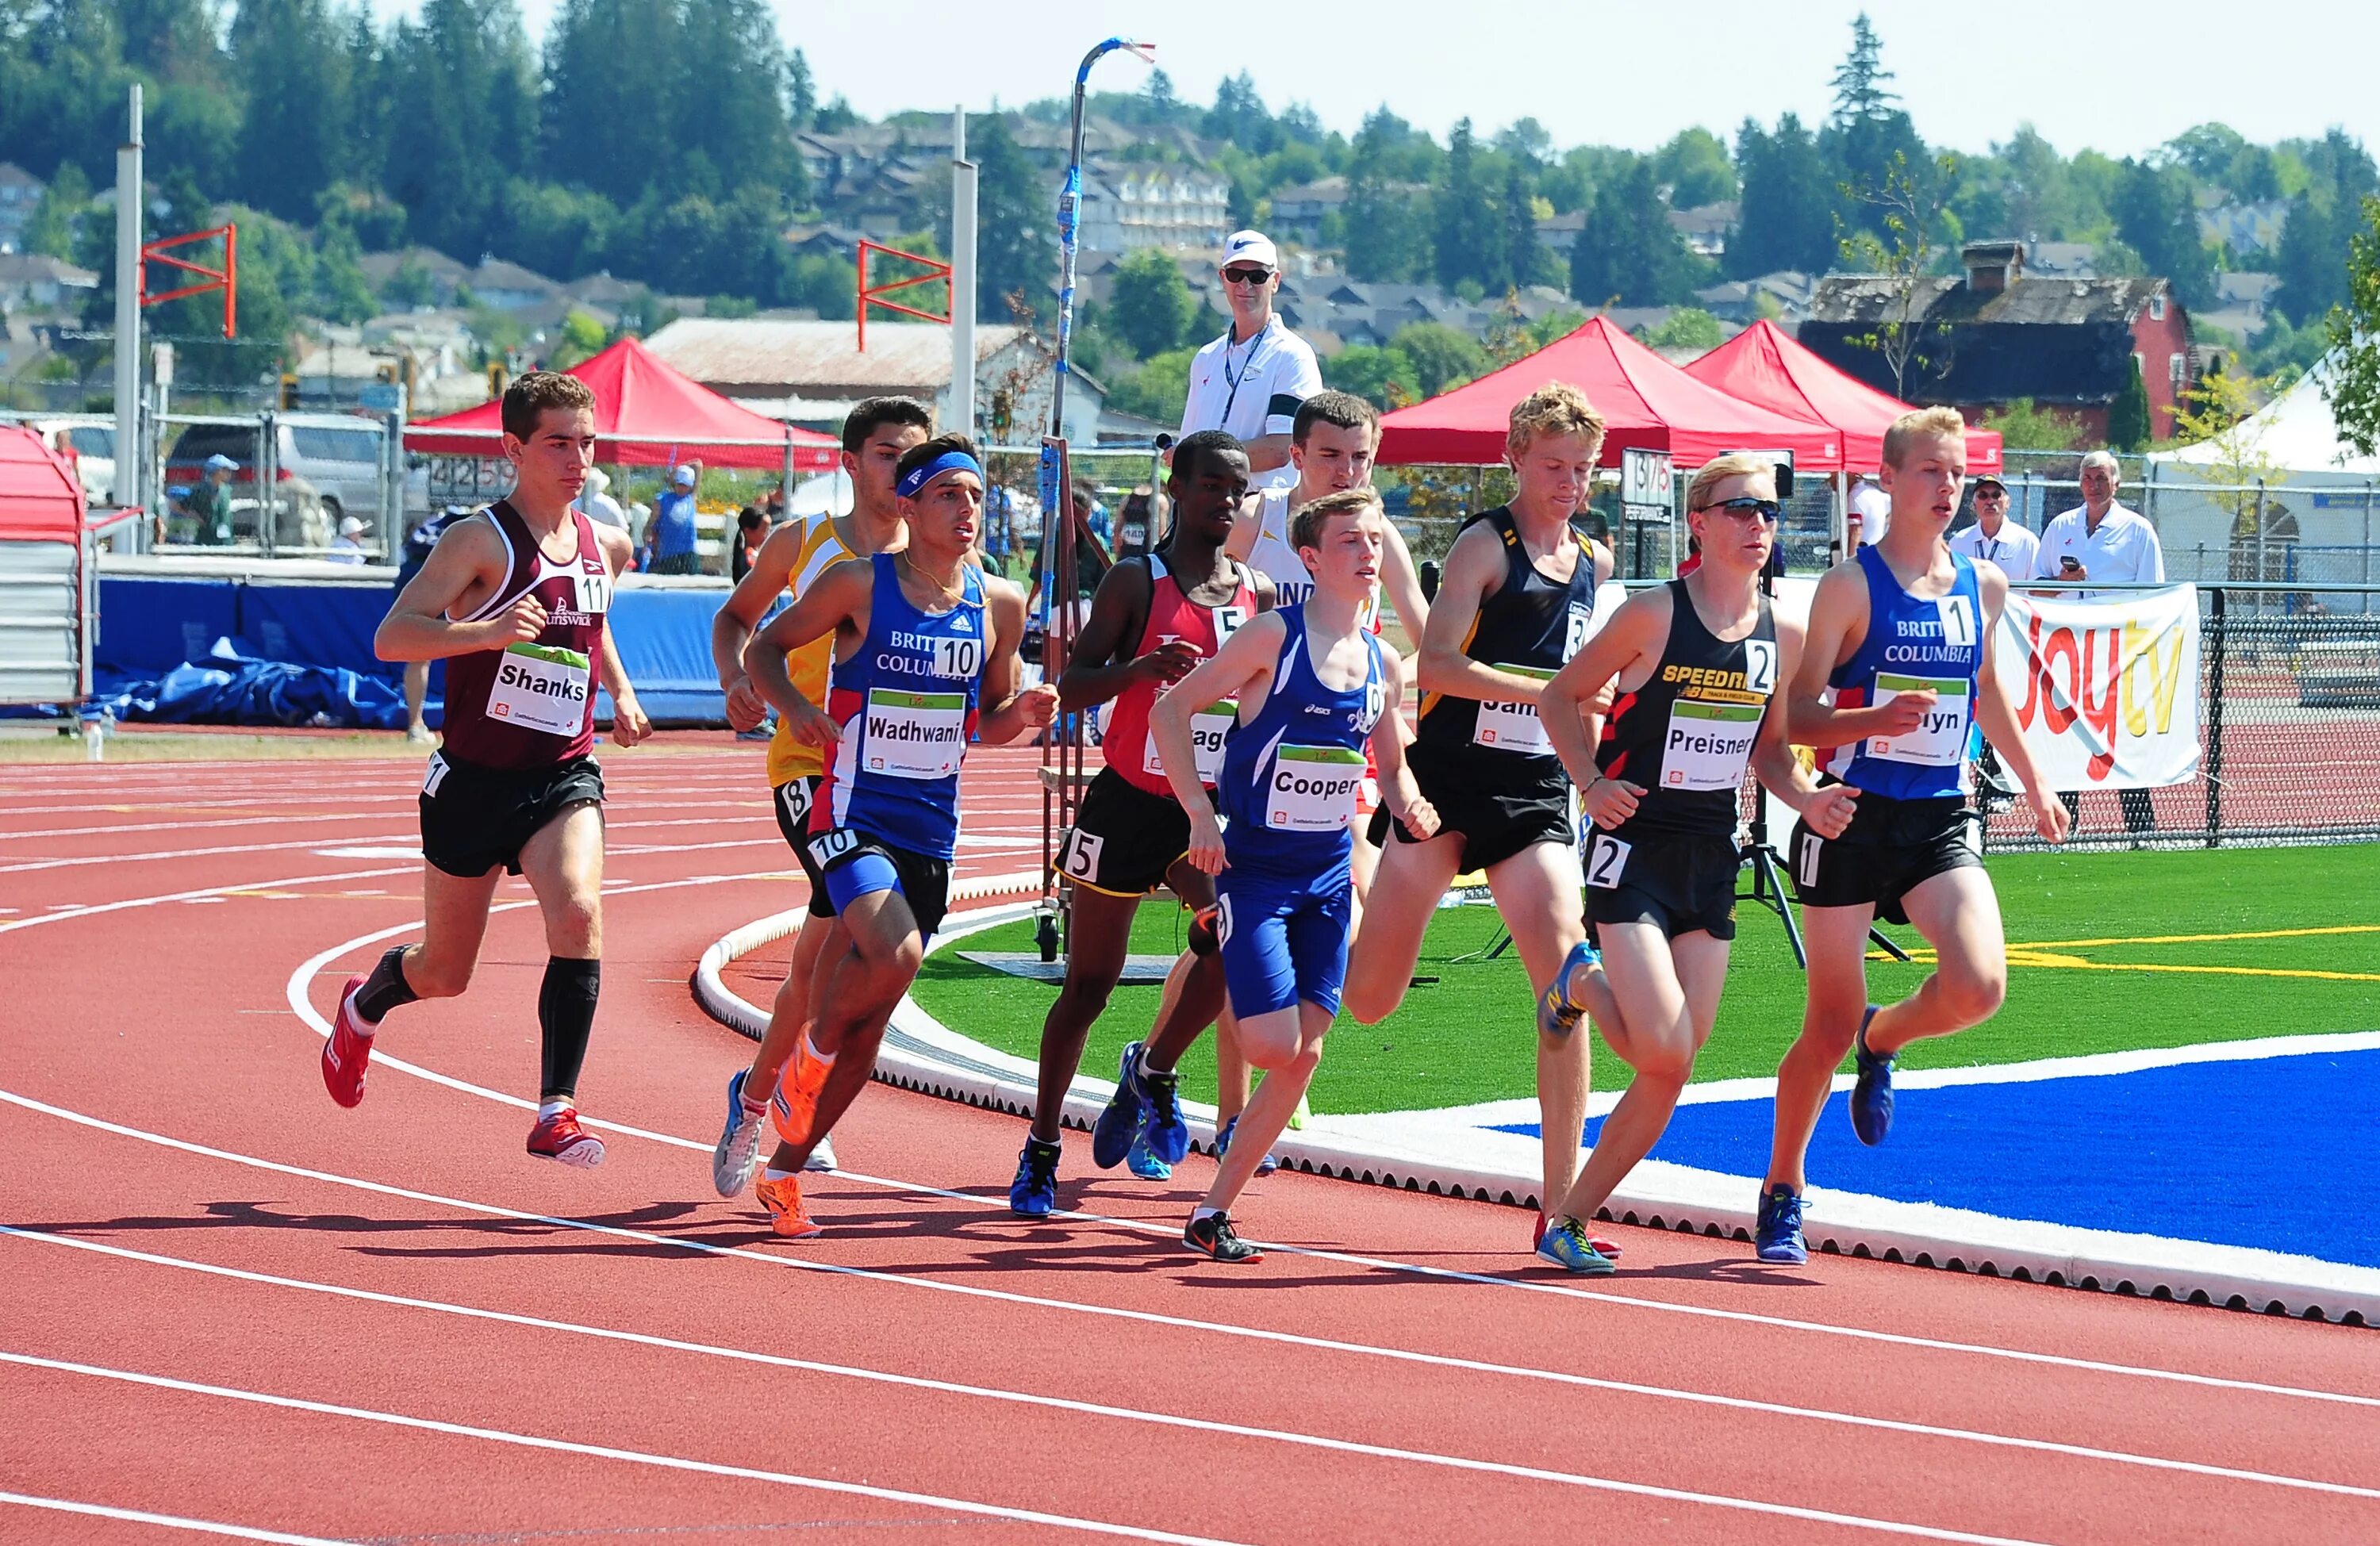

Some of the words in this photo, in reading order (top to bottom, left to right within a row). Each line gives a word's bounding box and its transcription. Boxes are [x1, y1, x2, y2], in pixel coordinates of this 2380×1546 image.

[583, 577, 603, 611] 11
[1222, 610, 1238, 632] 5
[1896, 620, 1944, 638] BRITI
[1948, 600, 1967, 642] 1
[943, 640, 974, 675] 10
[1568, 620, 1583, 661] 3
[1884, 645, 1973, 664] COLUMBIA
[499, 664, 585, 702] Shanks
[1754, 644, 1768, 689] 2
[869, 716, 960, 743] Wadhwani
[1669, 729, 1752, 755] Preisner
[790, 780, 806, 817] 8
[1275, 771, 1361, 801] Cooper
[816, 832, 848, 859] 10
[1071, 836, 1096, 877] 5
[1593, 839, 1619, 884] 2
[1802, 838, 1812, 882] 1
